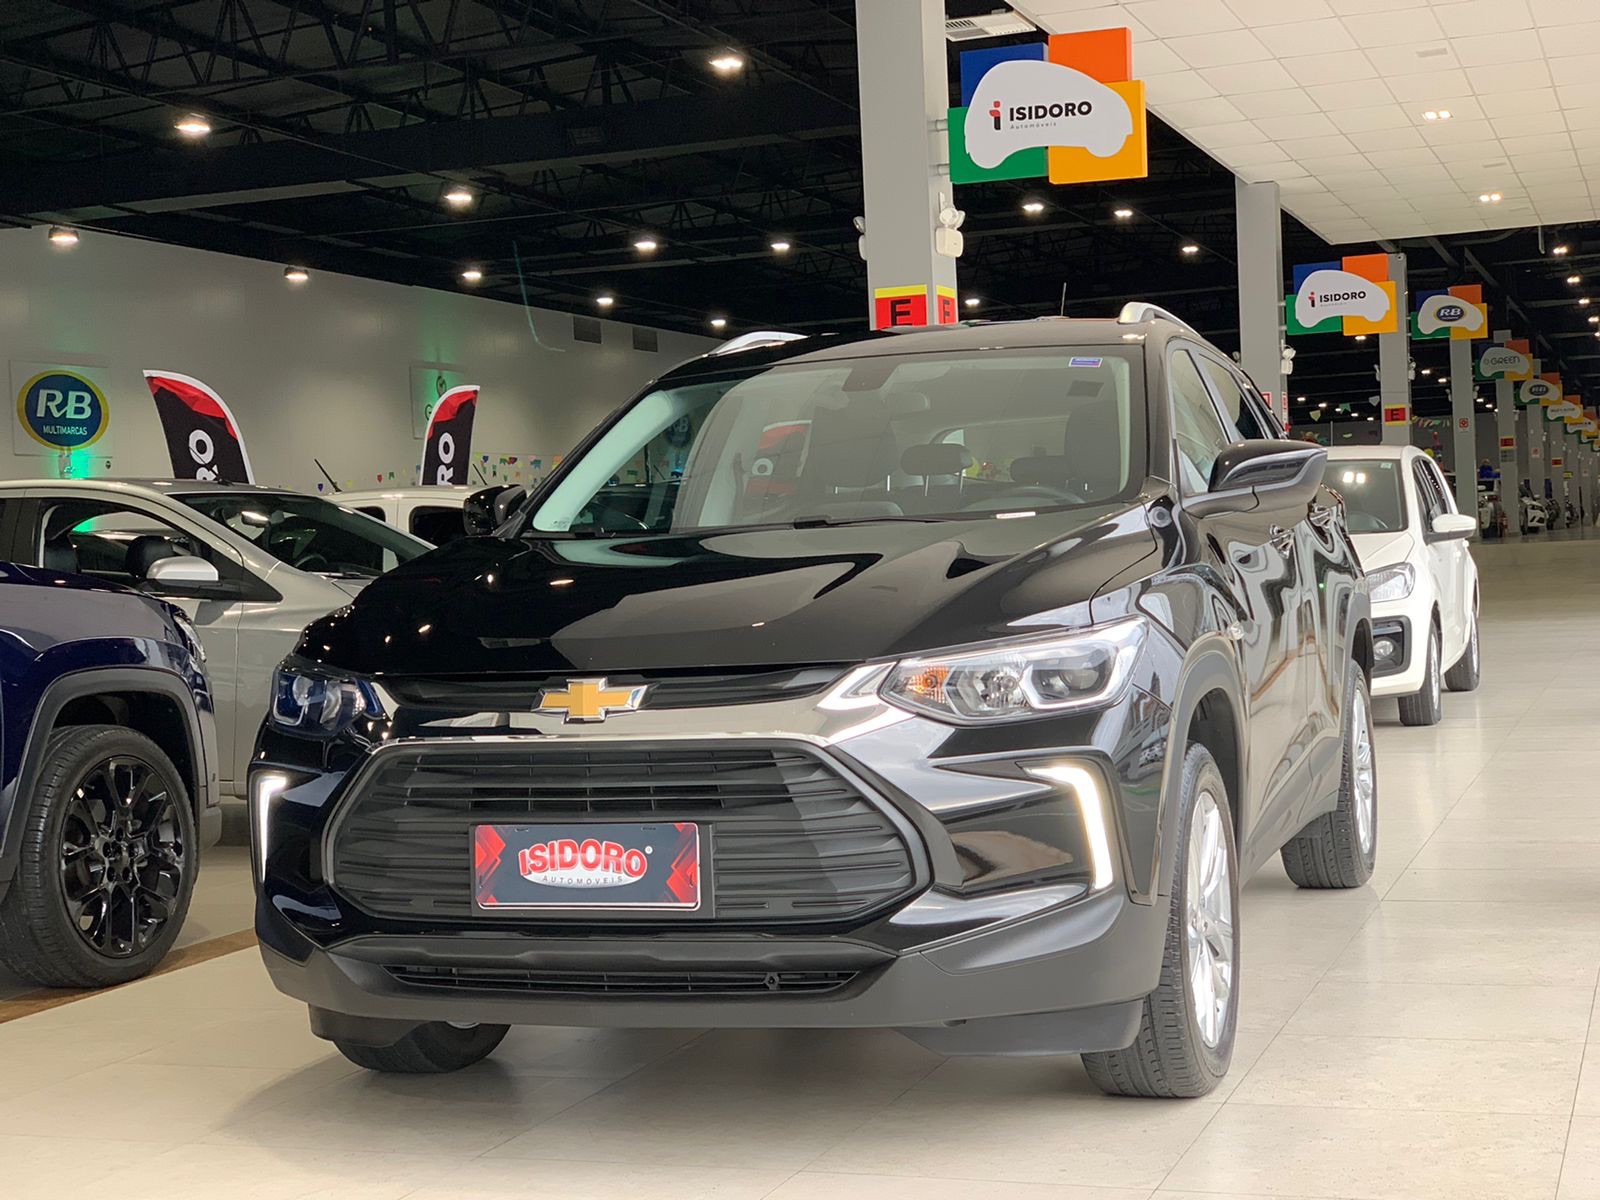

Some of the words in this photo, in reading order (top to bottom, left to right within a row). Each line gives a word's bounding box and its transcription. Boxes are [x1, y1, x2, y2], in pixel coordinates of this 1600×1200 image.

[1009, 101, 1092, 122] ISIDORO
[1320, 291, 1367, 303] ISIDORO
[1440, 308, 1461, 317] RB
[36, 389, 92, 419] RB
[43, 425, 88, 436] MULTIMARCAS
[518, 838, 648, 878] ISIDORO
